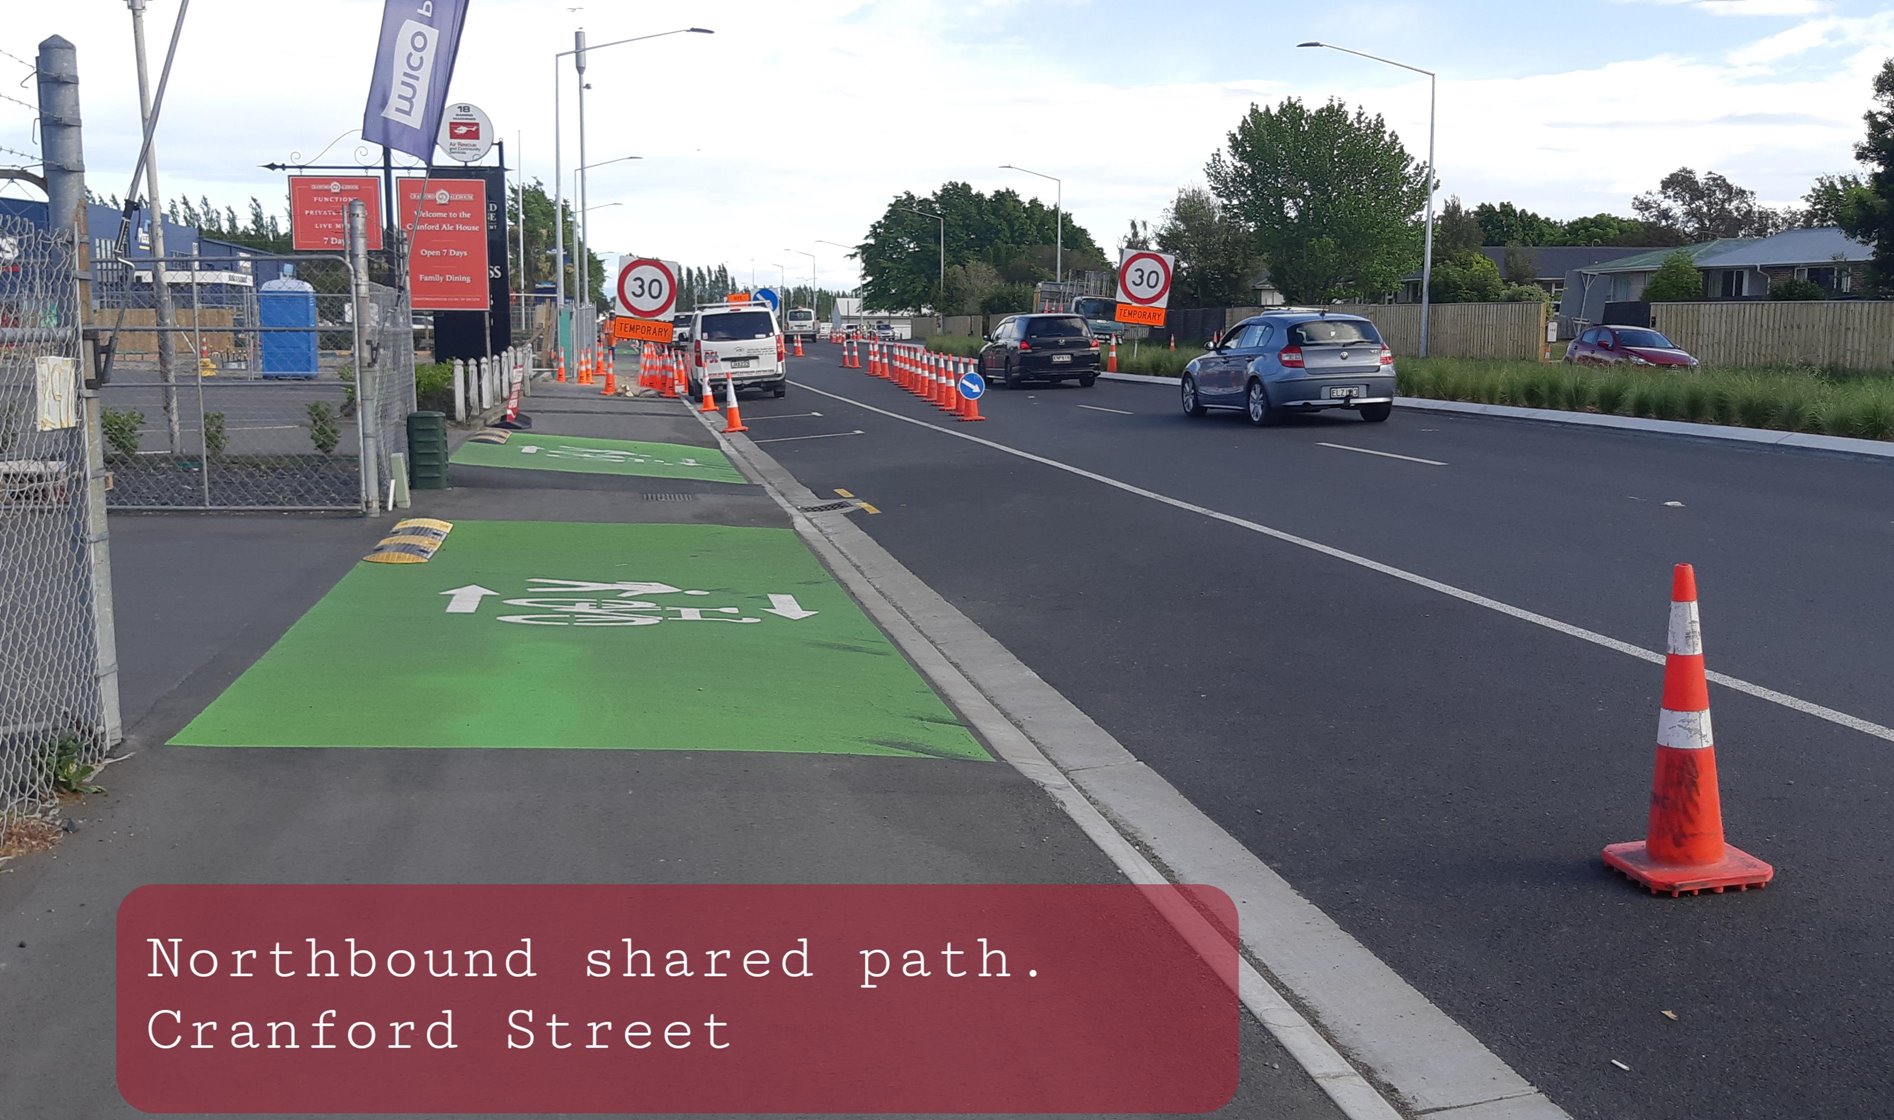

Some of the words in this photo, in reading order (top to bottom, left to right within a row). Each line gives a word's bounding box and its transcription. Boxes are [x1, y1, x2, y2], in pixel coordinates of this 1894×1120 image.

[457, 105, 471, 113] 18
[459, 211, 471, 219] the
[420, 248, 441, 258] Open
[449, 249, 468, 258] Days
[419, 274, 444, 283] Family
[446, 275, 471, 284] Dining
[1131, 267, 1160, 289] 30
[631, 276, 663, 300] 30
[1119, 308, 1162, 321] TEMPORARY
[619, 322, 669, 337] TEMPORARY
